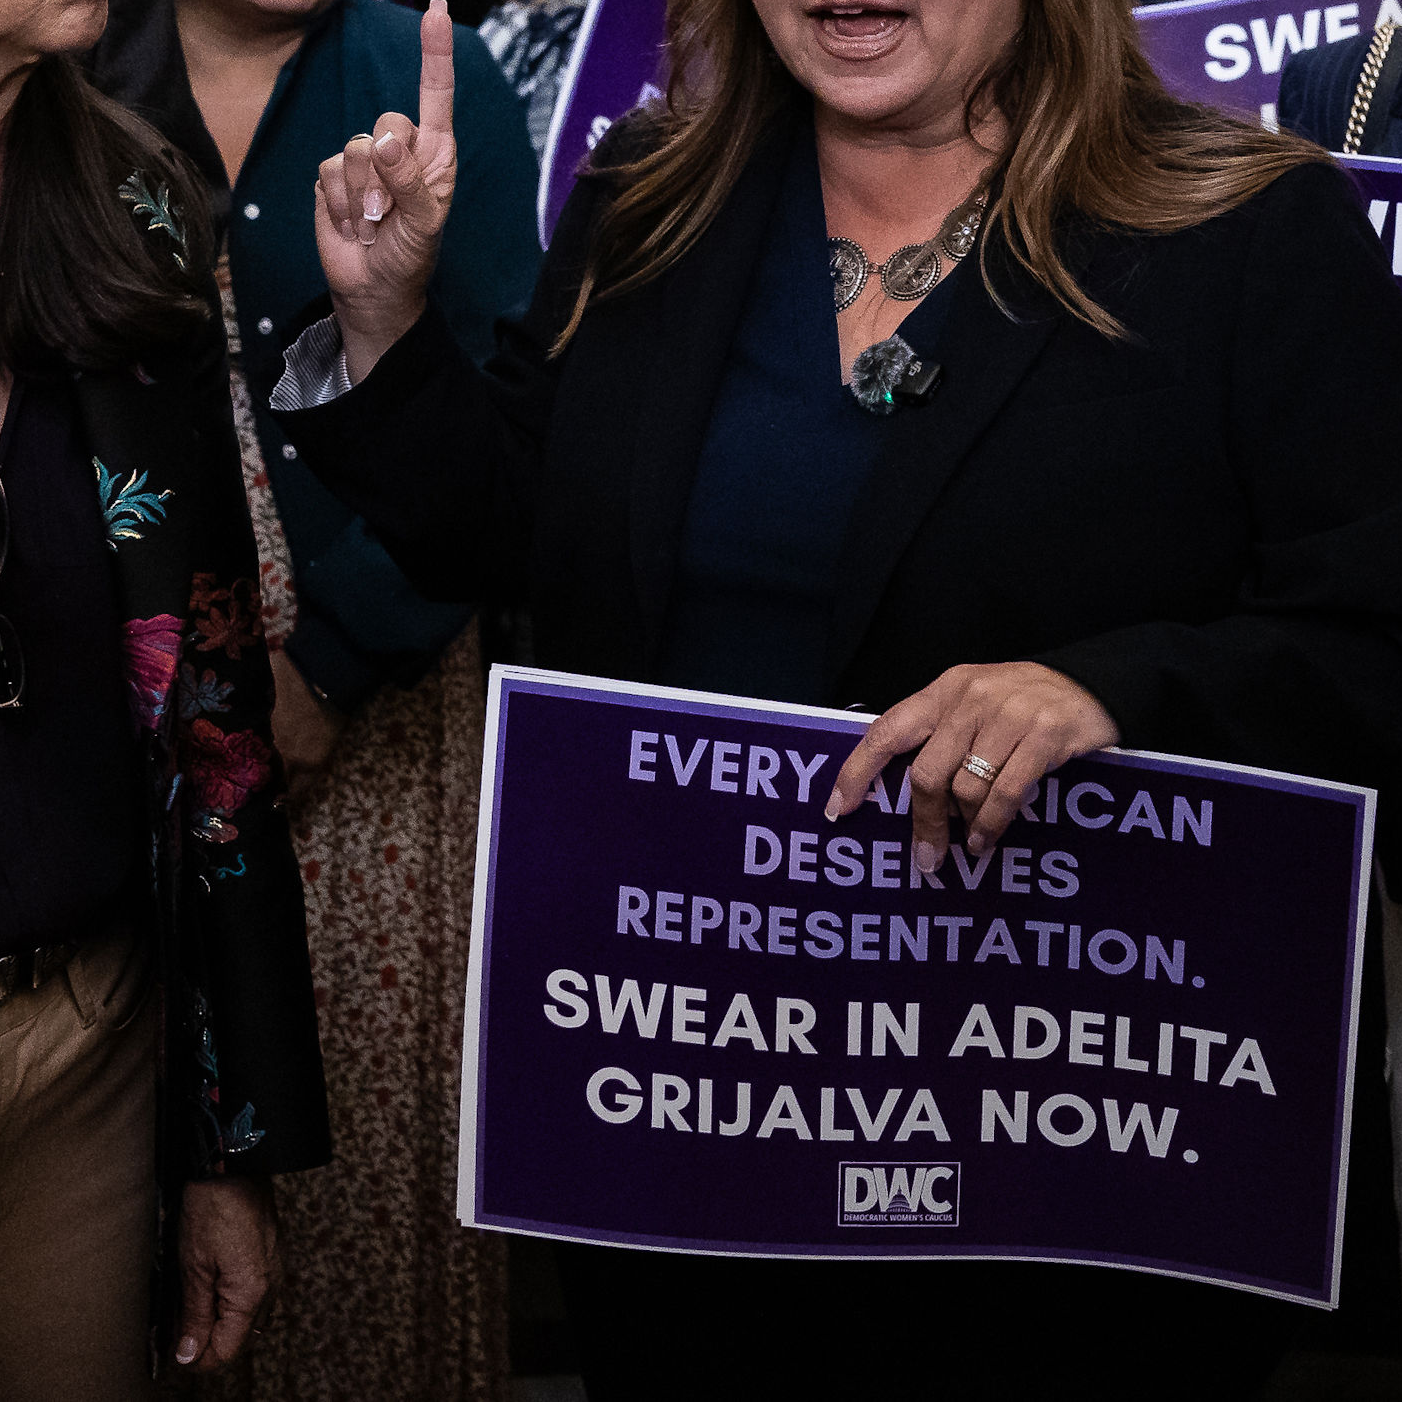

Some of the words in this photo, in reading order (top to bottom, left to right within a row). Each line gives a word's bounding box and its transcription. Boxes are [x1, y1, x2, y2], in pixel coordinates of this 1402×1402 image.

[628, 730, 829, 802] EVERY
[616, 886, 1207, 990] REPRESENTATION.
[543, 969, 818, 1056] SWEAR
[846, 1002, 921, 1058] IN
[947, 1003, 1277, 1097] ADELITA
[585, 1067, 952, 1144] GRIJALVA
[980, 1089, 1201, 1165] NOW.
[843, 1214, 888, 1222] DEMOCRATIC
[889, 1214, 923, 1222] WOMEN'S
[924, 1214, 953, 1222] CAUCUS
[844, 1166, 954, 1213] DWC
